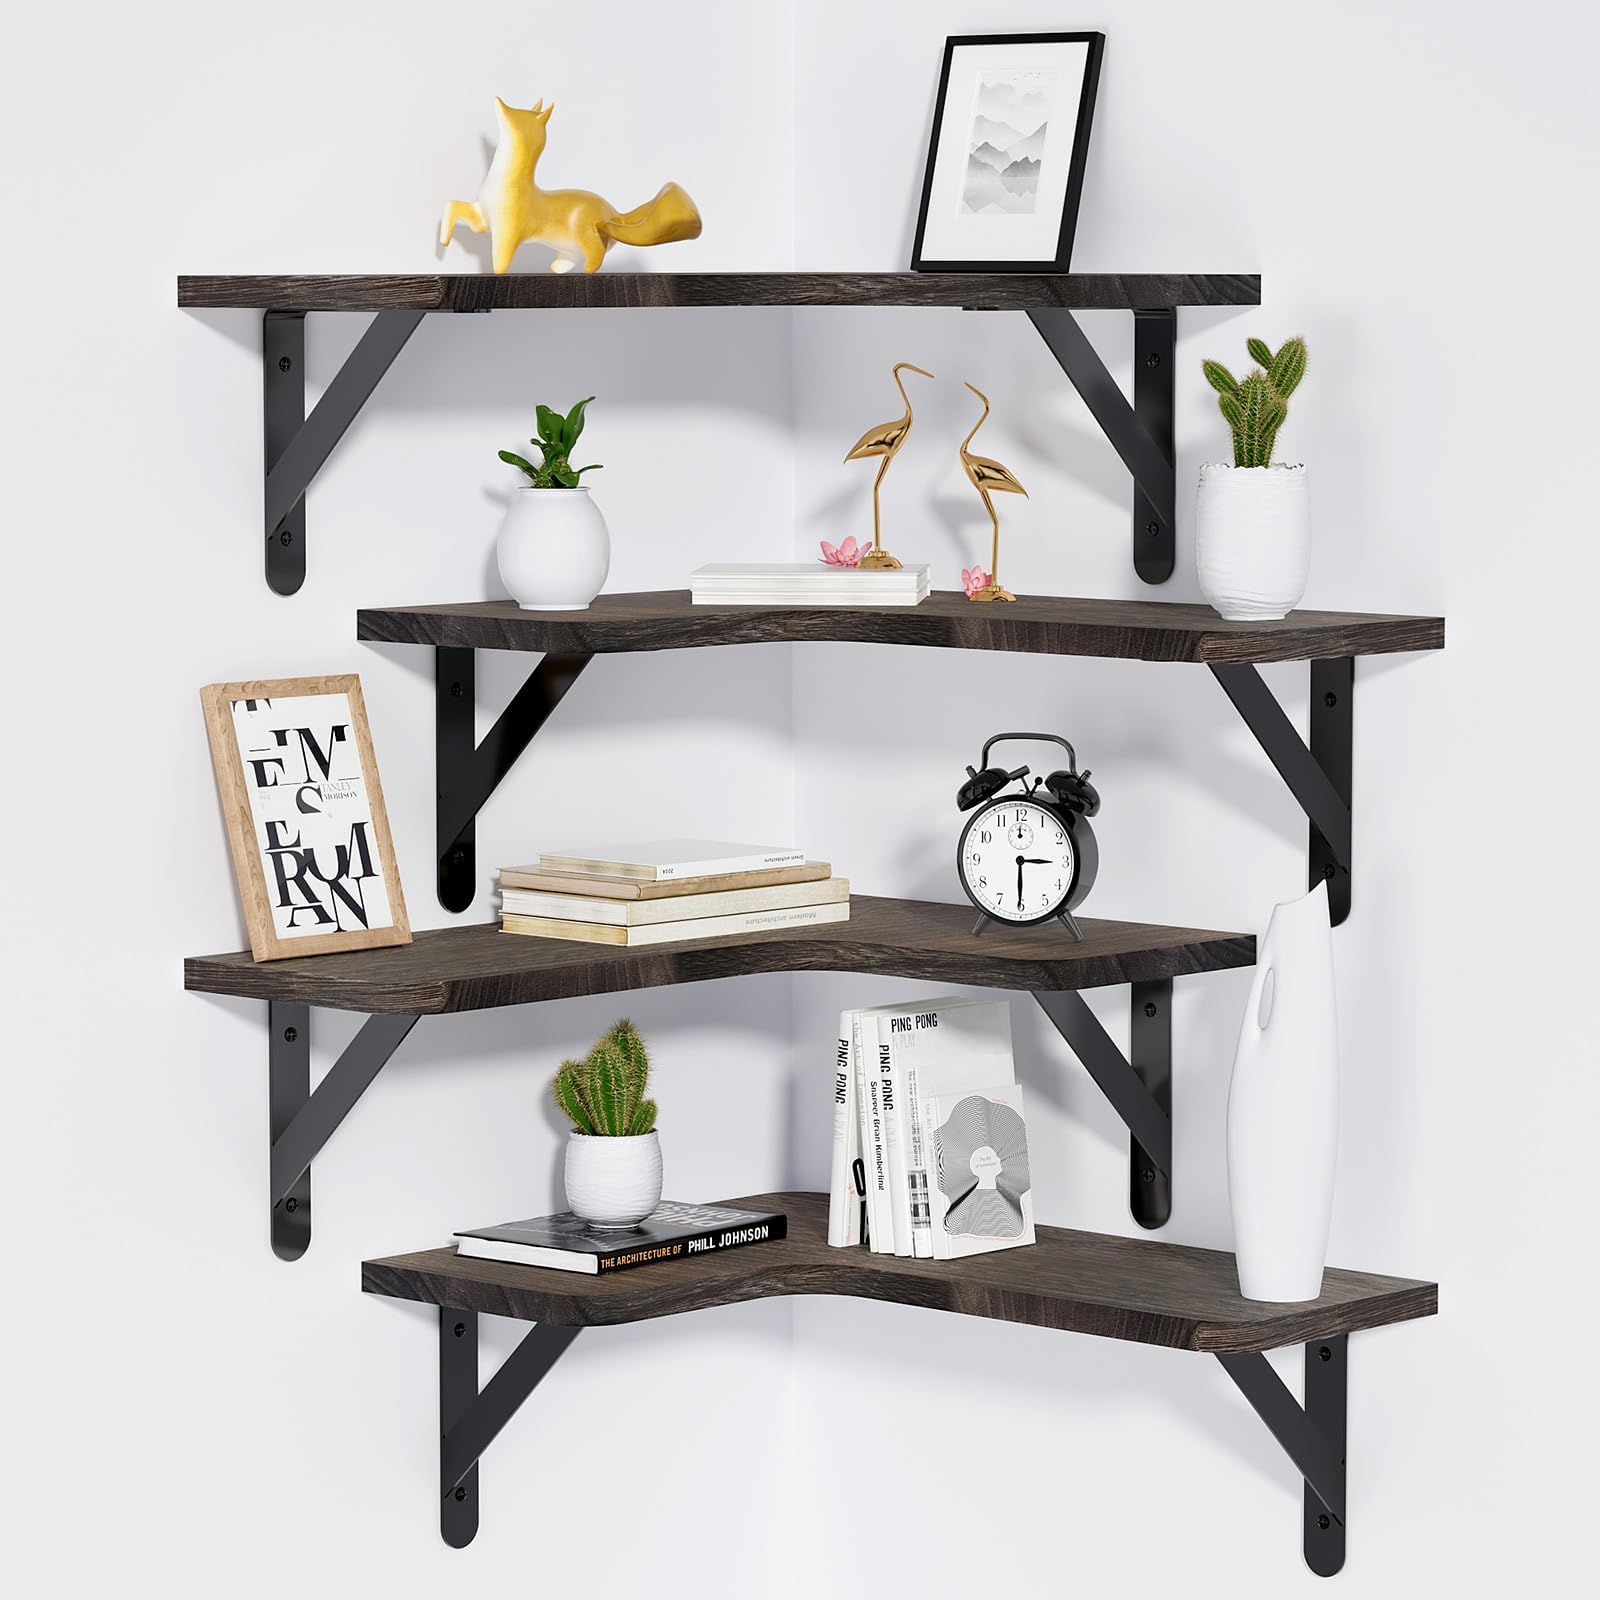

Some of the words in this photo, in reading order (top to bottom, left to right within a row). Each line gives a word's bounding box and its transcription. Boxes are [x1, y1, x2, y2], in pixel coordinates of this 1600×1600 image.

[323, 791, 358, 801] MORISON
[996, 815, 1006, 827] 11
[1015, 809, 1028, 822] 12
[1040, 815, 1045, 828] 1
[981, 830, 992, 844] 10
[1055, 832, 1063, 845] 2
[763, 855, 790, 863] architecture
[972, 853, 981, 866] 9
[1062, 855, 1070, 869] 3
[979, 876, 987, 888] 8
[1054, 878, 1062, 890] 4
[996, 892, 1004, 905] 7
[1041, 894, 1049, 906] 5
[745, 915, 788, 925] architecture
[788, 911, 817, 920] Modern
[891, 1017, 912, 1033] PING
[916, 1013, 938, 1029] PONG
[837, 1039, 849, 1068] PING
[879, 1044, 891, 1073] PING
[835, 1073, 847, 1104] PONG
[882, 1079, 894, 1110] PONG
[870, 1081, 879, 1116] Snapper
[872, 1119, 881, 1142] Brian
[875, 1144, 885, 1191] Kimberling
[601, 1257, 615, 1269] THE
[616, 1247, 671, 1265] ARCHITECTURE
[672, 1244, 683, 1256] OF
[688, 1237, 716, 1253] PHILL
[718, 1225, 769, 1247] JOHNSON
